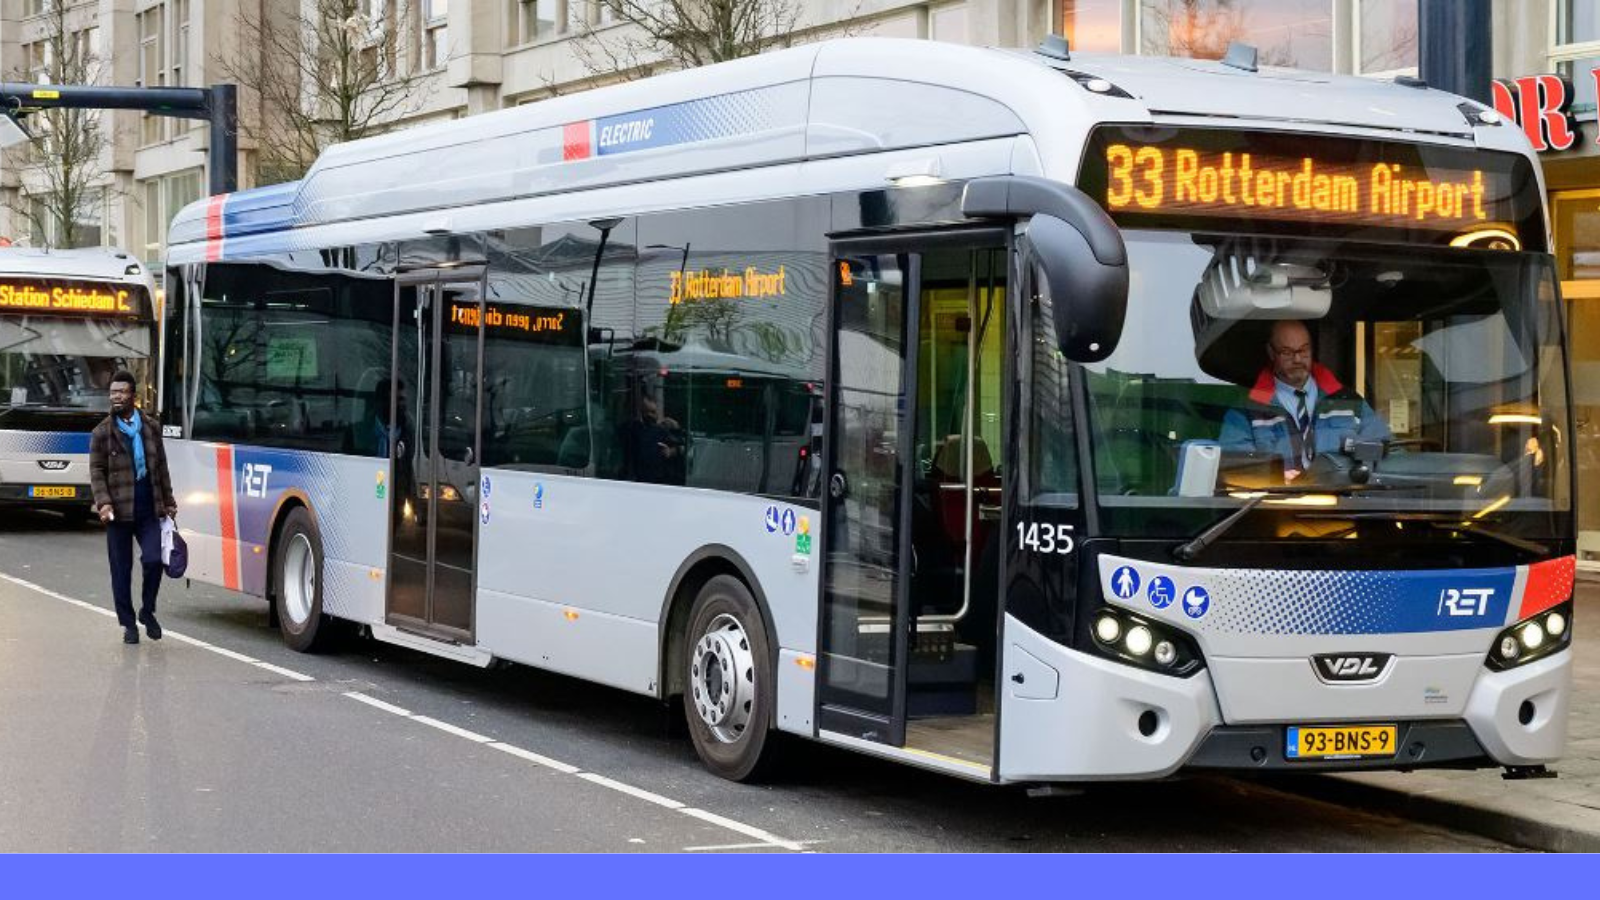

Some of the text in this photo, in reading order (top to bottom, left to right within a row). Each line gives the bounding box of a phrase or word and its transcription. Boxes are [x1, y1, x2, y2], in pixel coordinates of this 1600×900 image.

[600, 118, 654, 147] ELECTRIC
[1106, 144, 1487, 220] 33 Rotterdam Airport
[685, 268, 742, 298] Rotterdam
[745, 265, 785, 297] Airport
[0, 284, 131, 311] Station Schiedam C.
[241, 462, 272, 498] RET
[1017, 521, 1074, 554] 1435
[1437, 588, 1495, 616] RET
[1324, 657, 1378, 676] VDL
[1304, 731, 1390, 752] 93-BNS-9
